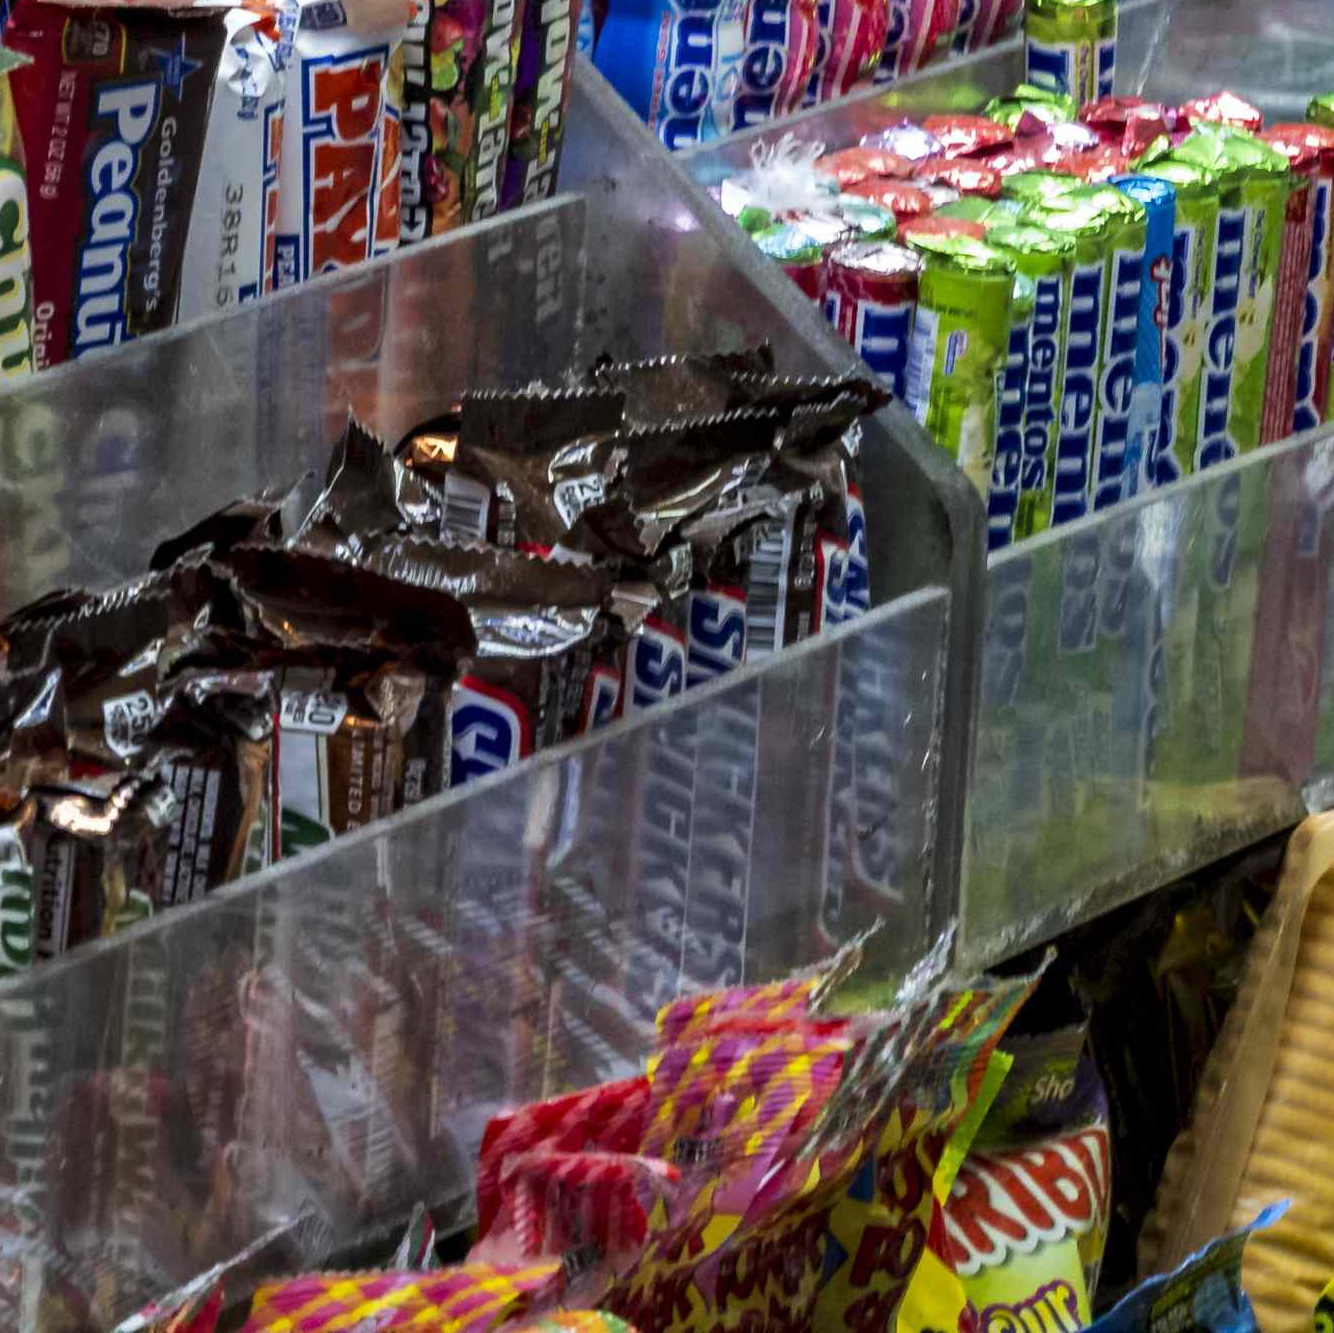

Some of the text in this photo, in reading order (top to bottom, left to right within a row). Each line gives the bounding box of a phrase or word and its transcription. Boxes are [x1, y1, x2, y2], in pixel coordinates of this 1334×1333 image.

[71, 78, 167, 360] Peanu
[145, 116, 177, 314] Goldenberg's
[1021, 275, 1063, 492] mentos
[1053, 263, 1106, 530] men
[1094, 248, 1147, 514] men
